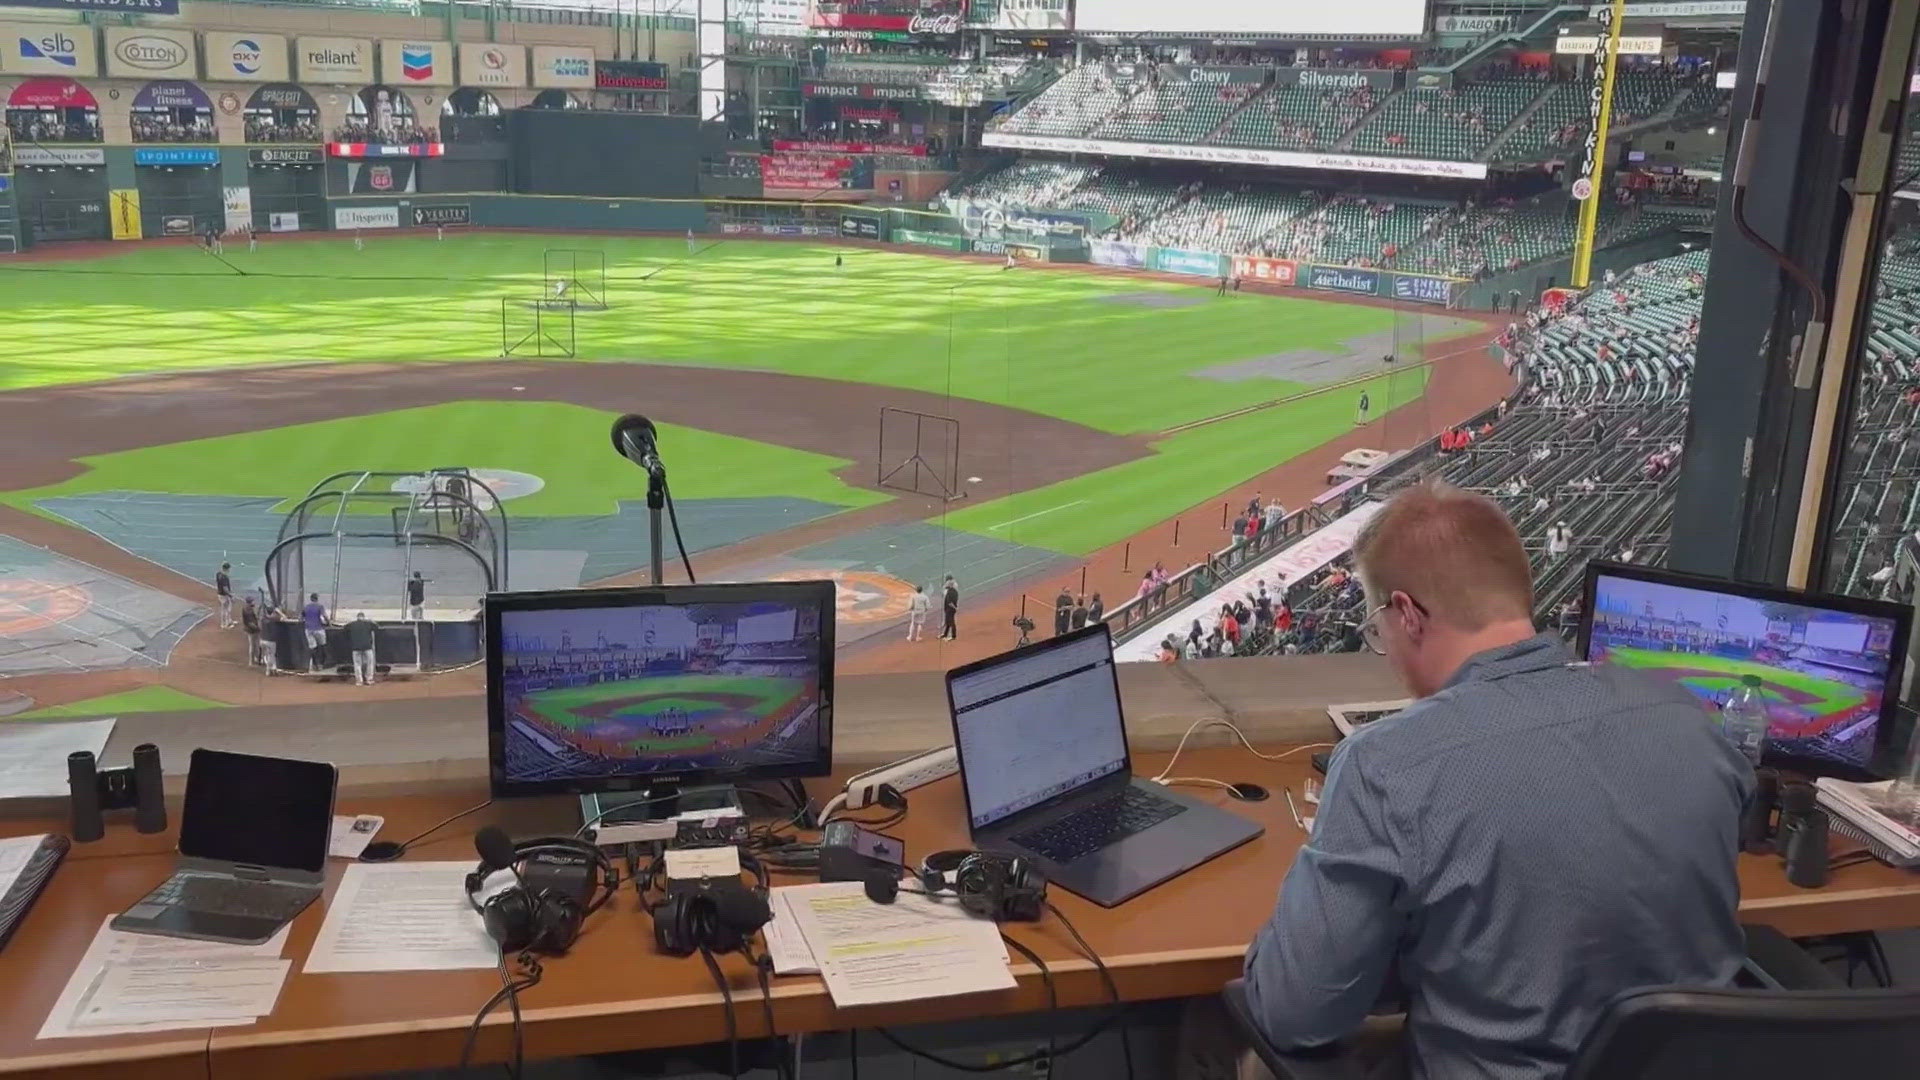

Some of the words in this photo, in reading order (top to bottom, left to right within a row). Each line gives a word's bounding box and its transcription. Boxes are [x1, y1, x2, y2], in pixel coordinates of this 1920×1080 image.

[1460, 19, 1509, 30] NABO
[42, 33, 75, 53] slb
[124, 43, 177, 63] COTTON
[232, 53, 260, 61] OXY
[308, 49, 358, 65] reliant
[597, 72, 667, 89] Budweiser
[1190, 68, 1230, 84] Chevy
[1300, 71, 1368, 87] Silverado
[151, 85, 185, 97] planet
[813, 84, 858, 97] impact
[873, 86, 917, 99] impact
[157, 95, 193, 105] fitness
[352, 211, 396, 223] Insperity
[1314, 273, 1373, 292] Methodist
[1413, 277, 1450, 290] ENERG
[1414, 286, 1450, 300] TRANS
